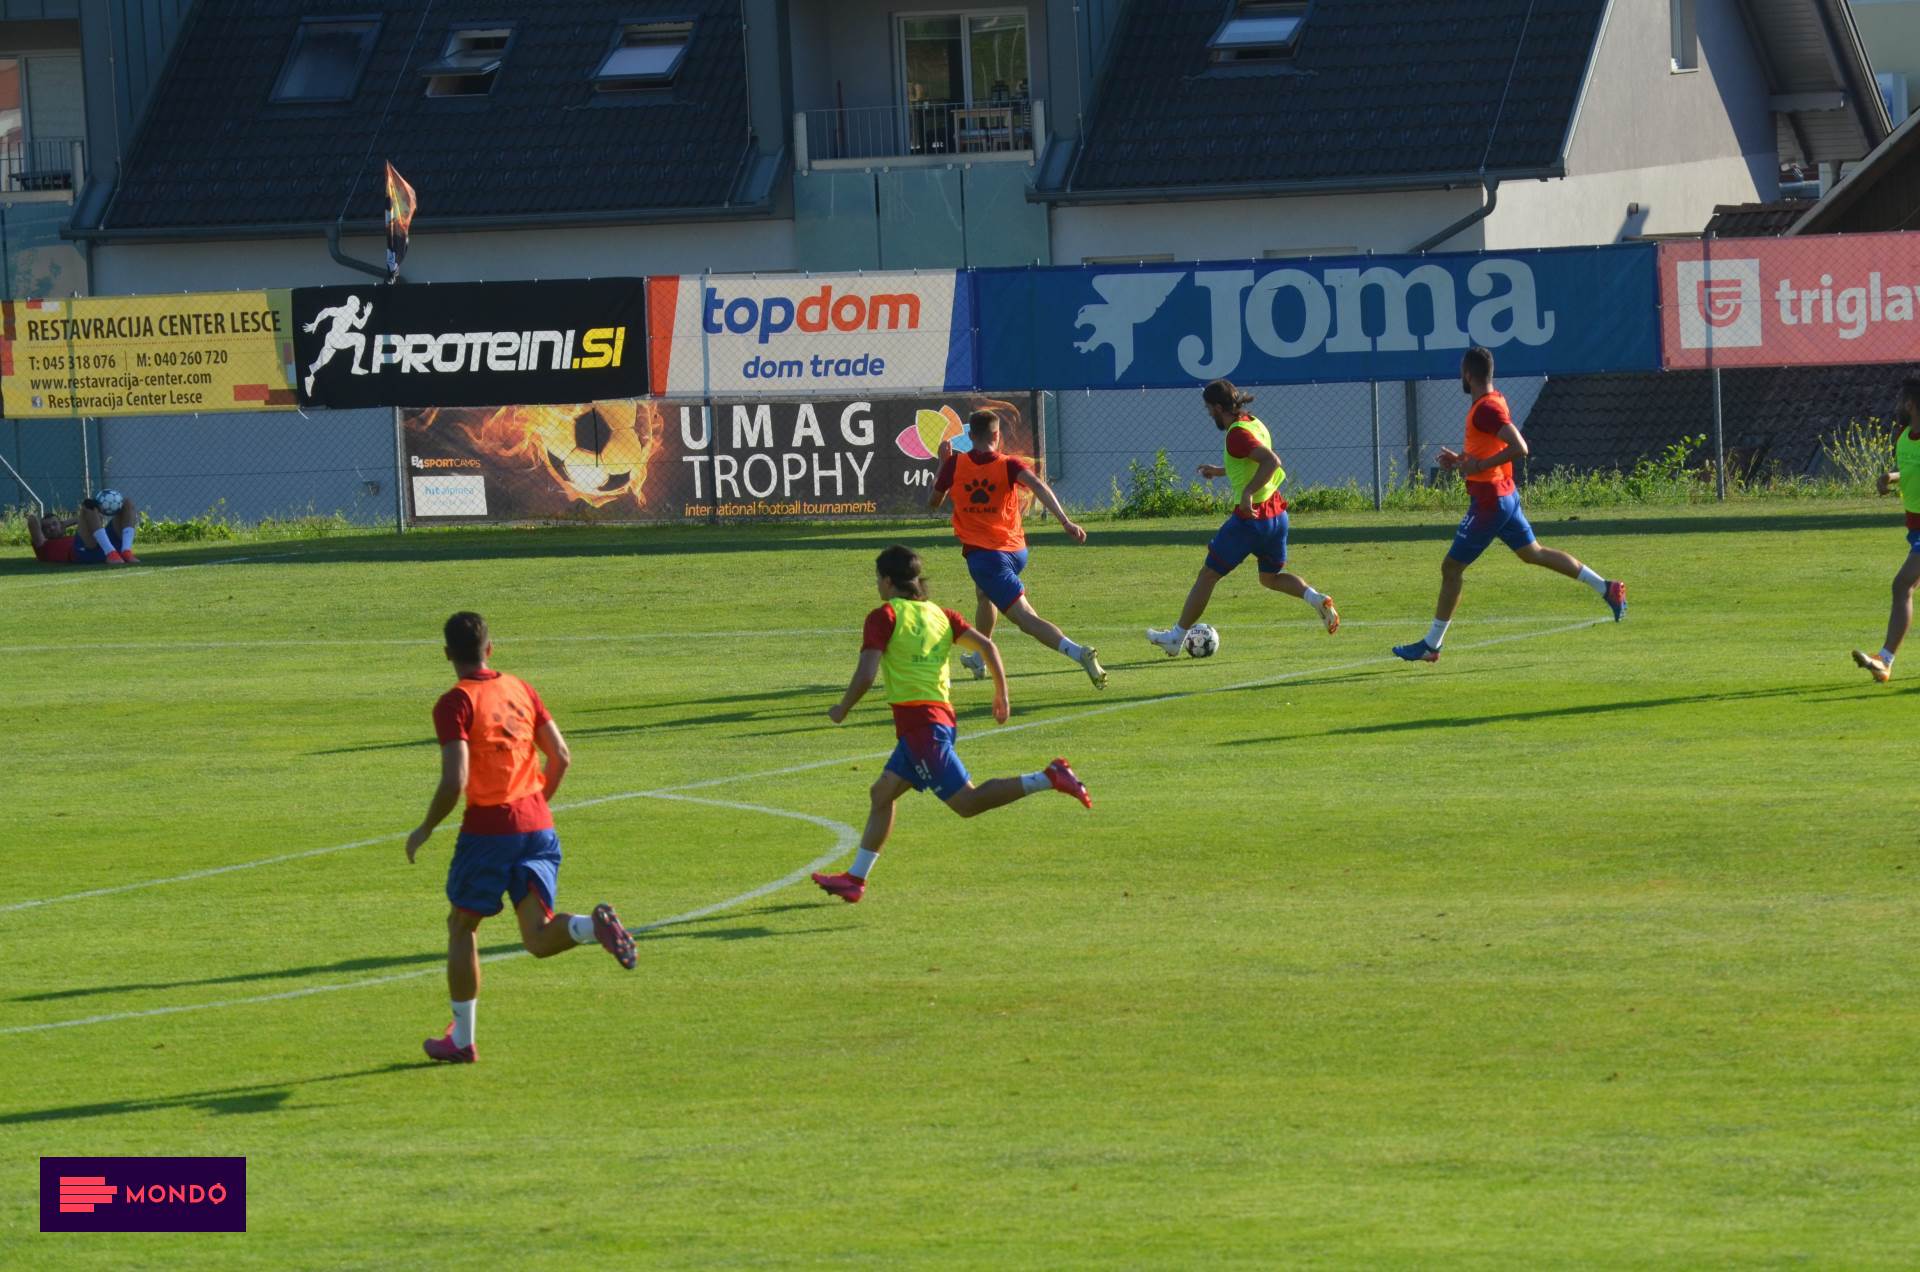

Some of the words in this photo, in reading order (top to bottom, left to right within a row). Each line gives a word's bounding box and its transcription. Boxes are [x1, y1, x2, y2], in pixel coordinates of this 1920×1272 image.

[702, 285, 921, 344] topdom
[1775, 272, 1920, 340] trigla
[27, 316, 153, 341] RESTAVRACIJA
[158, 312, 225, 336] CENTER
[230, 310, 282, 333] LESCE
[29, 356, 40, 371] T:
[43, 355, 65, 370] 045
[68, 355, 90, 370] 318
[93, 354, 116, 369] 076
[137, 353, 151, 367] M:
[154, 352, 178, 366] 040
[181, 351, 202, 366] 260
[205, 350, 228, 365] 720
[742, 355, 803, 379] dom
[809, 353, 885, 378] trade
[30, 372, 212, 391] www.restavracija-center.com
[47, 392, 123, 410] Restavracija
[127, 391, 168, 407] Center
[170, 390, 202, 405] Lesce
[680, 401, 875, 450] UMAG
[683, 451, 875, 499] TROPHY
[758, 500, 801, 516] football
[803, 500, 877, 515] tournaments
